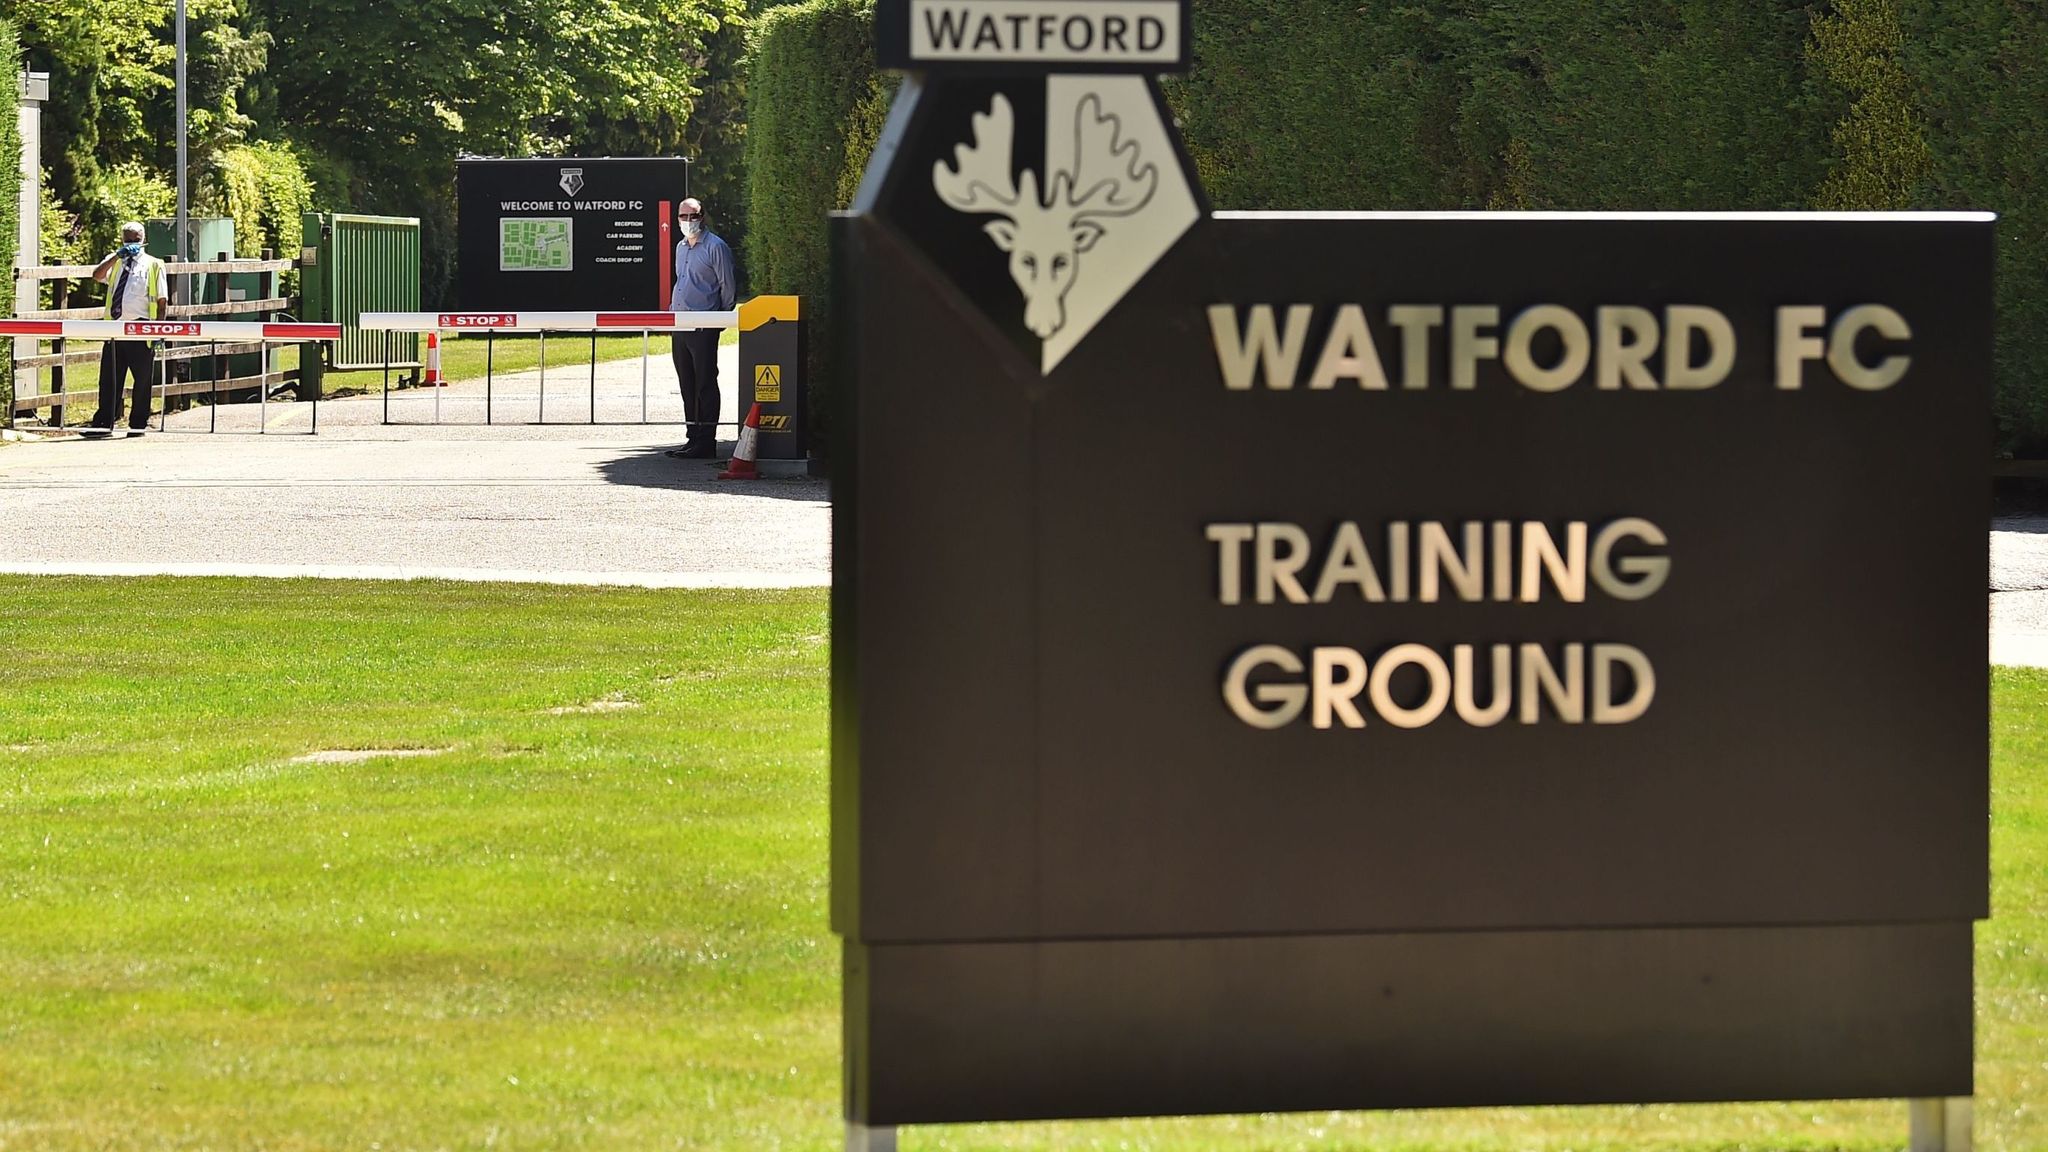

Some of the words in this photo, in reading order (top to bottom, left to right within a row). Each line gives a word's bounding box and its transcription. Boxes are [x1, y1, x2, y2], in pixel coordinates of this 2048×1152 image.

[924, 9, 1166, 53] WATFORD
[500, 201, 554, 211] WELCOME
[556, 201, 571, 210] TO
[574, 200, 626, 211] WATFORD
[629, 200, 643, 210] FC
[142, 325, 183, 334] STOP
[456, 316, 499, 325] STOP
[1208, 304, 1737, 392] WATFORD
[1775, 303, 1913, 392] FC
[1205, 517, 1671, 604] TRAINING
[1222, 643, 1656, 729] GROUND
